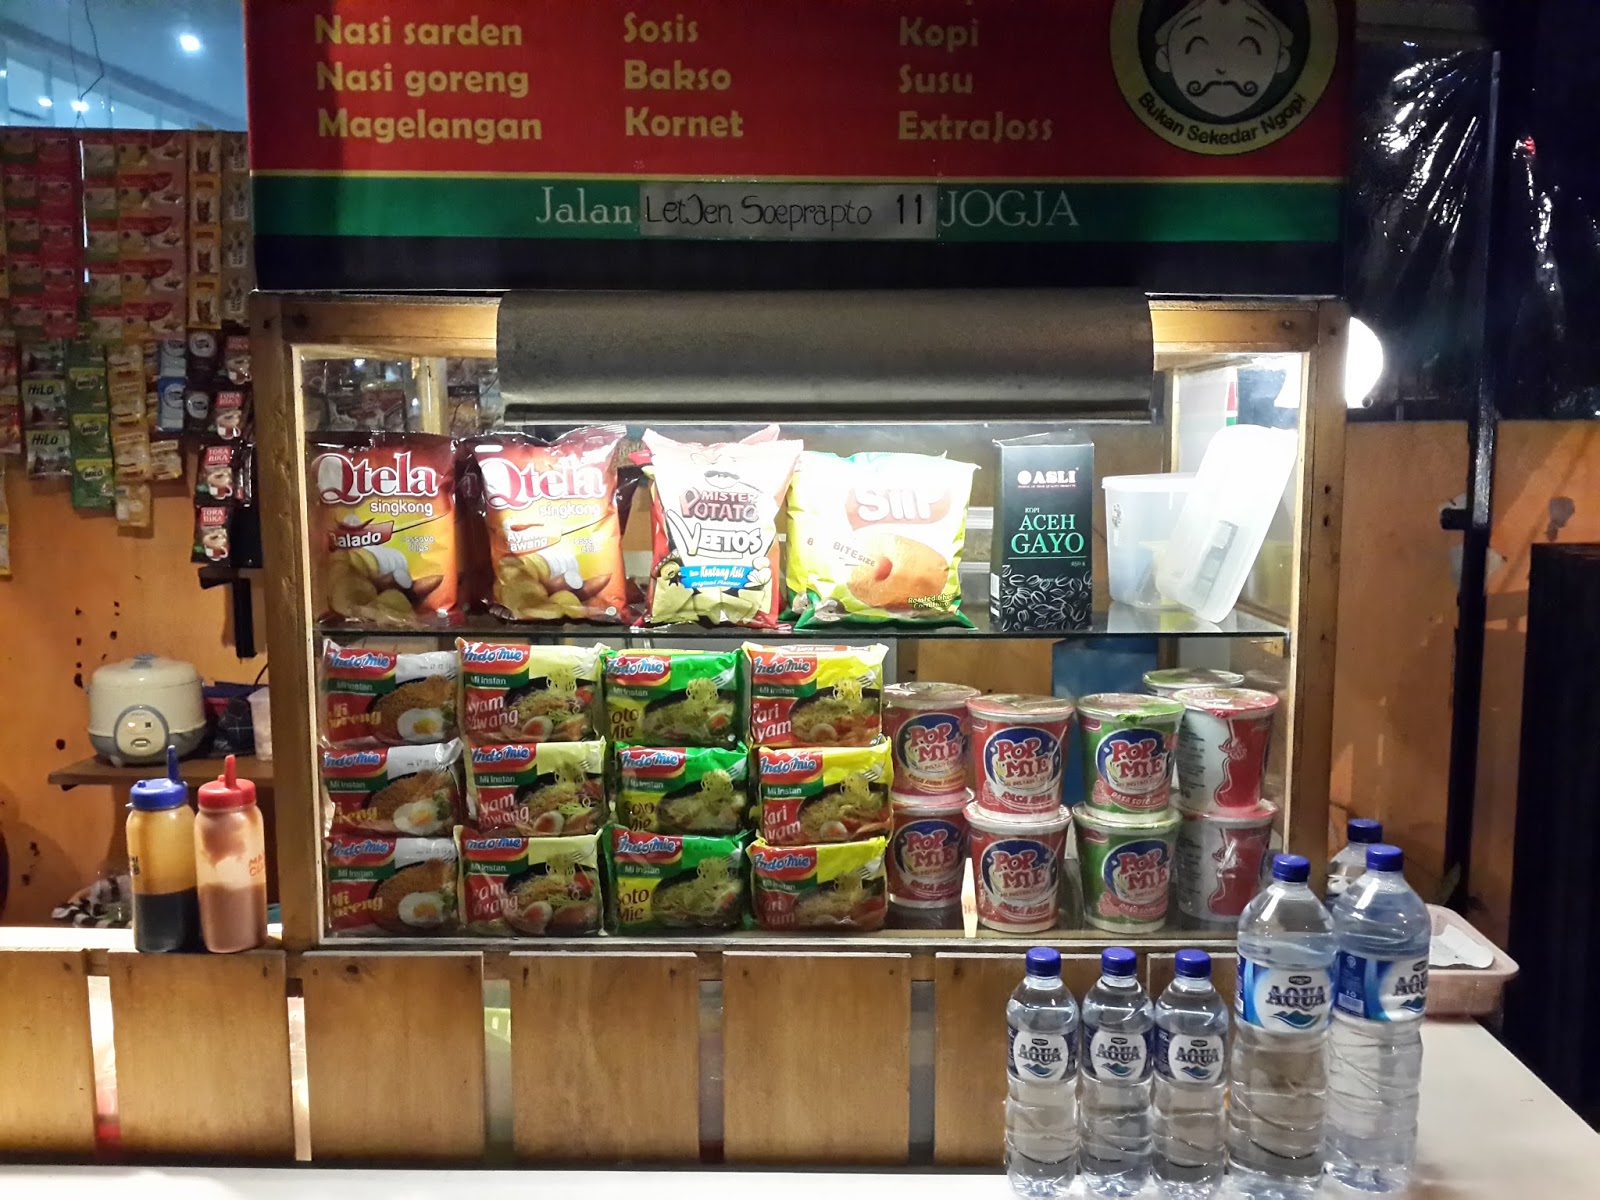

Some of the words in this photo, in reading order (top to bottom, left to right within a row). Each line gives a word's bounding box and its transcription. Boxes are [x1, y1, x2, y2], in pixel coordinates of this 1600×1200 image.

[315, 15, 391, 45] Nasi
[404, 16, 522, 46] sarden
[623, 12, 699, 43] Sosis
[900, 16, 979, 53] Kopi
[317, 61, 393, 92] Nasi
[405, 68, 529, 98] goreng
[624, 59, 732, 91] Bakso
[900, 64, 974, 94] Susu
[318, 108, 542, 144] Magelangan
[625, 106, 744, 138] Kornet
[898, 110, 1054, 144] ExtraJoss
[1138, 91, 1185, 136] Bukan
[1187, 124, 1257, 145] Sekedar
[1260, 92, 1308, 135] Ngopi
[535, 186, 633, 224] Jalan
[740, 195, 873, 232] Soeprapto
[896, 193, 922, 225] 11
[941, 189, 1080, 228] JOGJA
[312, 451, 439, 504] Qtela
[1034, 471, 1077, 484] ASLI
[679, 487, 759, 522] POTATO
[702, 490, 758, 502] MISTER
[370, 500, 433, 516] singkong
[539, 502, 602, 518] singkong
[667, 509, 762, 555] VEETOS
[1019, 514, 1075, 531] ACEH
[509, 537, 548, 552] awang
[1011, 532, 1085, 554] GAYO
[833, 541, 858, 558] BITE
[858, 555, 876, 567] SIZE
[463, 647, 523, 662] Indomie
[754, 655, 811, 674] Indomie
[606, 657, 665, 675] Indomie
[481, 677, 506, 686] Instan
[611, 708, 640, 724] oto
[323, 751, 381, 768] Indomie
[471, 745, 530, 762] Indomie
[621, 751, 679, 768] Indomie
[760, 756, 816, 774] Indomie
[480, 793, 514, 813] yam
[332, 840, 390, 856] Indomie
[618, 833, 676, 852] Indomie
[756, 853, 810, 872] Indomie
[1393, 970, 1429, 996] AQU
[1265, 985, 1326, 1012] AQUA
[1018, 1044, 1063, 1064] AQUA
[1096, 1043, 1141, 1064] AQUA
[1175, 1046, 1219, 1066] AQUA
